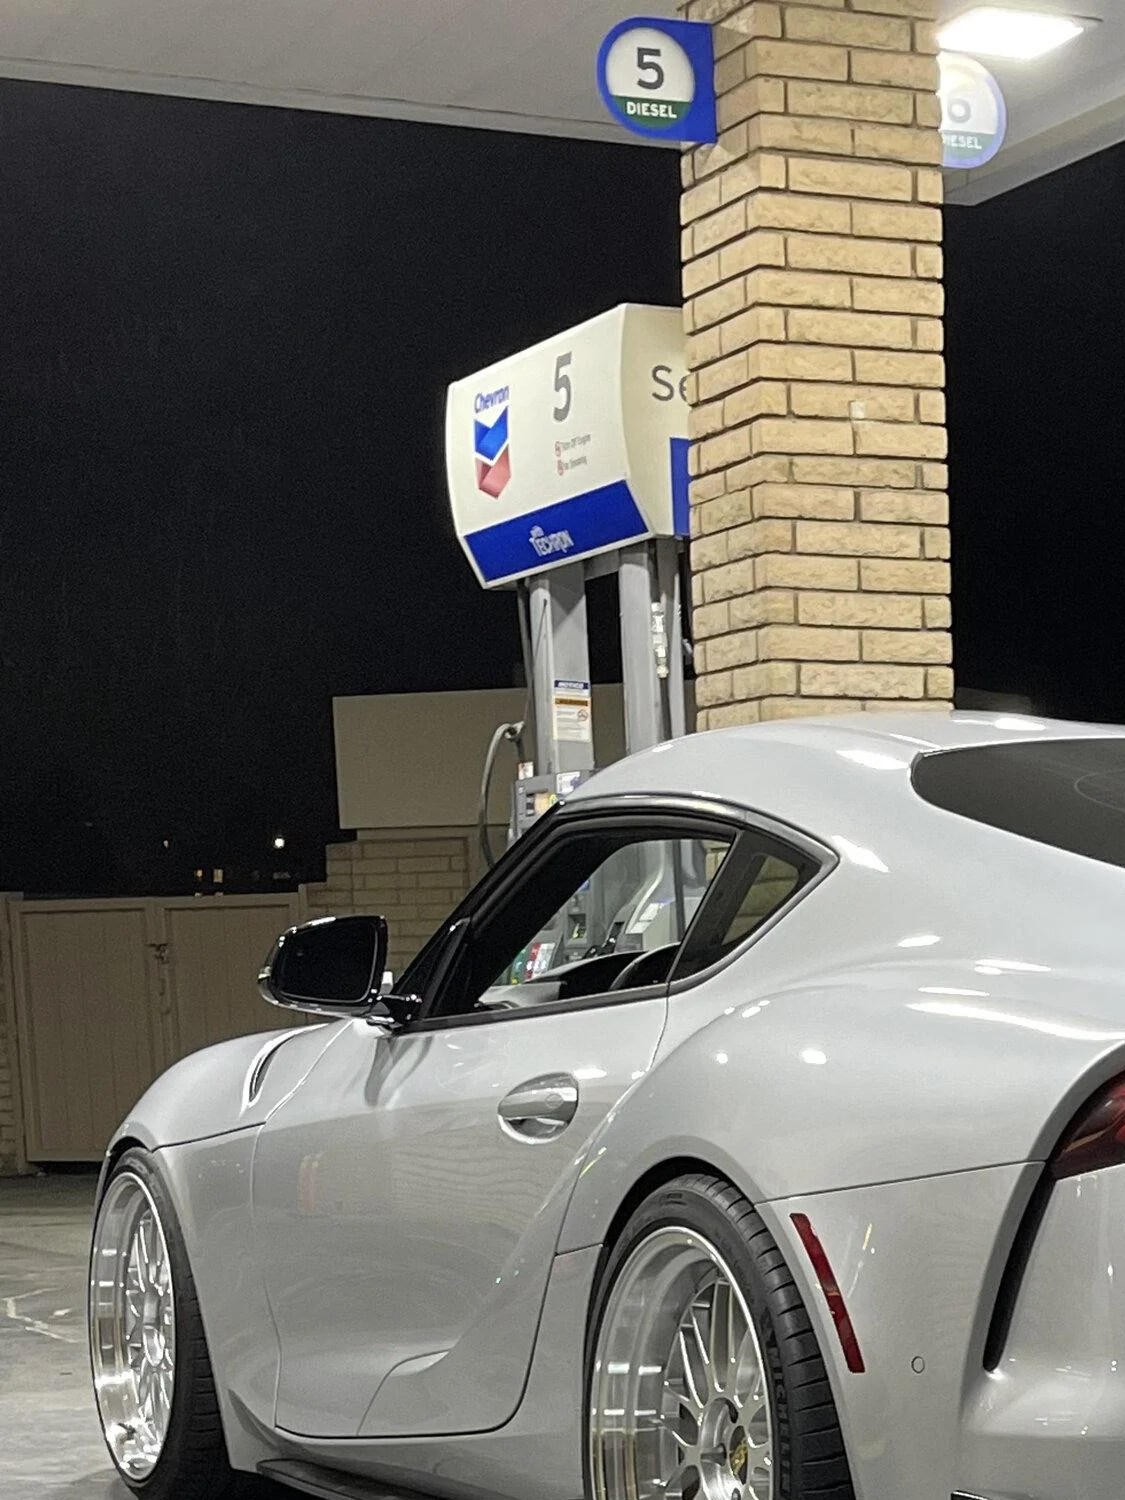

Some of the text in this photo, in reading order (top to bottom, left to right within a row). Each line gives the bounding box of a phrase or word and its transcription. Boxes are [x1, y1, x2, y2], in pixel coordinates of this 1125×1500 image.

[637, 47, 664, 90] 5
[626, 101, 677, 118] DIESEL
[943, 134, 982, 149] IESEL
[474, 385, 509, 413] Chevron
[553, 351, 572, 422] 5
